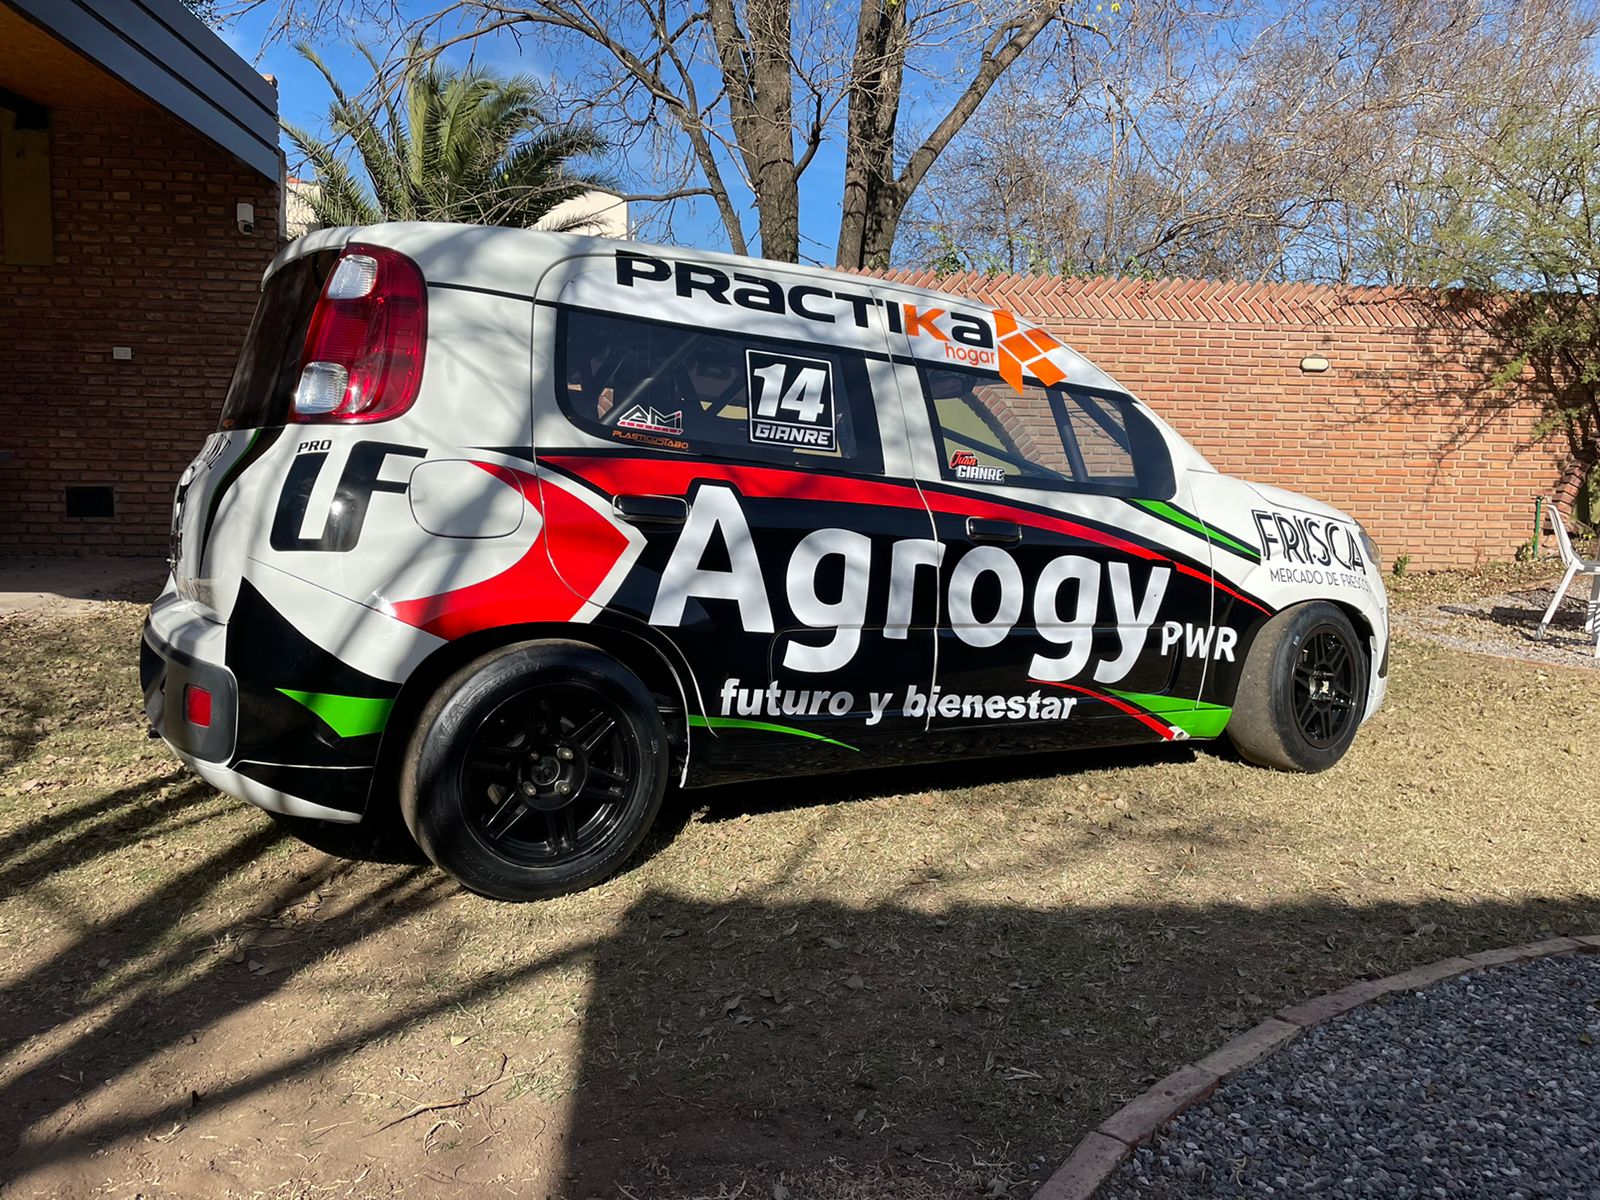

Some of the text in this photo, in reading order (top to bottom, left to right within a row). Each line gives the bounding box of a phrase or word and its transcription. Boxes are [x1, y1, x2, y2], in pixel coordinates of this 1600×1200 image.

[944, 342, 996, 366] hogar
[753, 362, 827, 422] 14
[298, 440, 332, 453] PRO
[755, 424, 832, 445] GIANRE
[949, 451, 977, 468] Juan
[957, 465, 1004, 481] GIANRE
[1251, 509, 1366, 575] FRISCA
[648, 484, 1171, 683] Agrogy
[1270, 568, 1323, 585] MERCADO
[1325, 571, 1340, 586] DE
[1161, 621, 1236, 662] PWR
[720, 678, 1077, 726] futuro y bienestar
